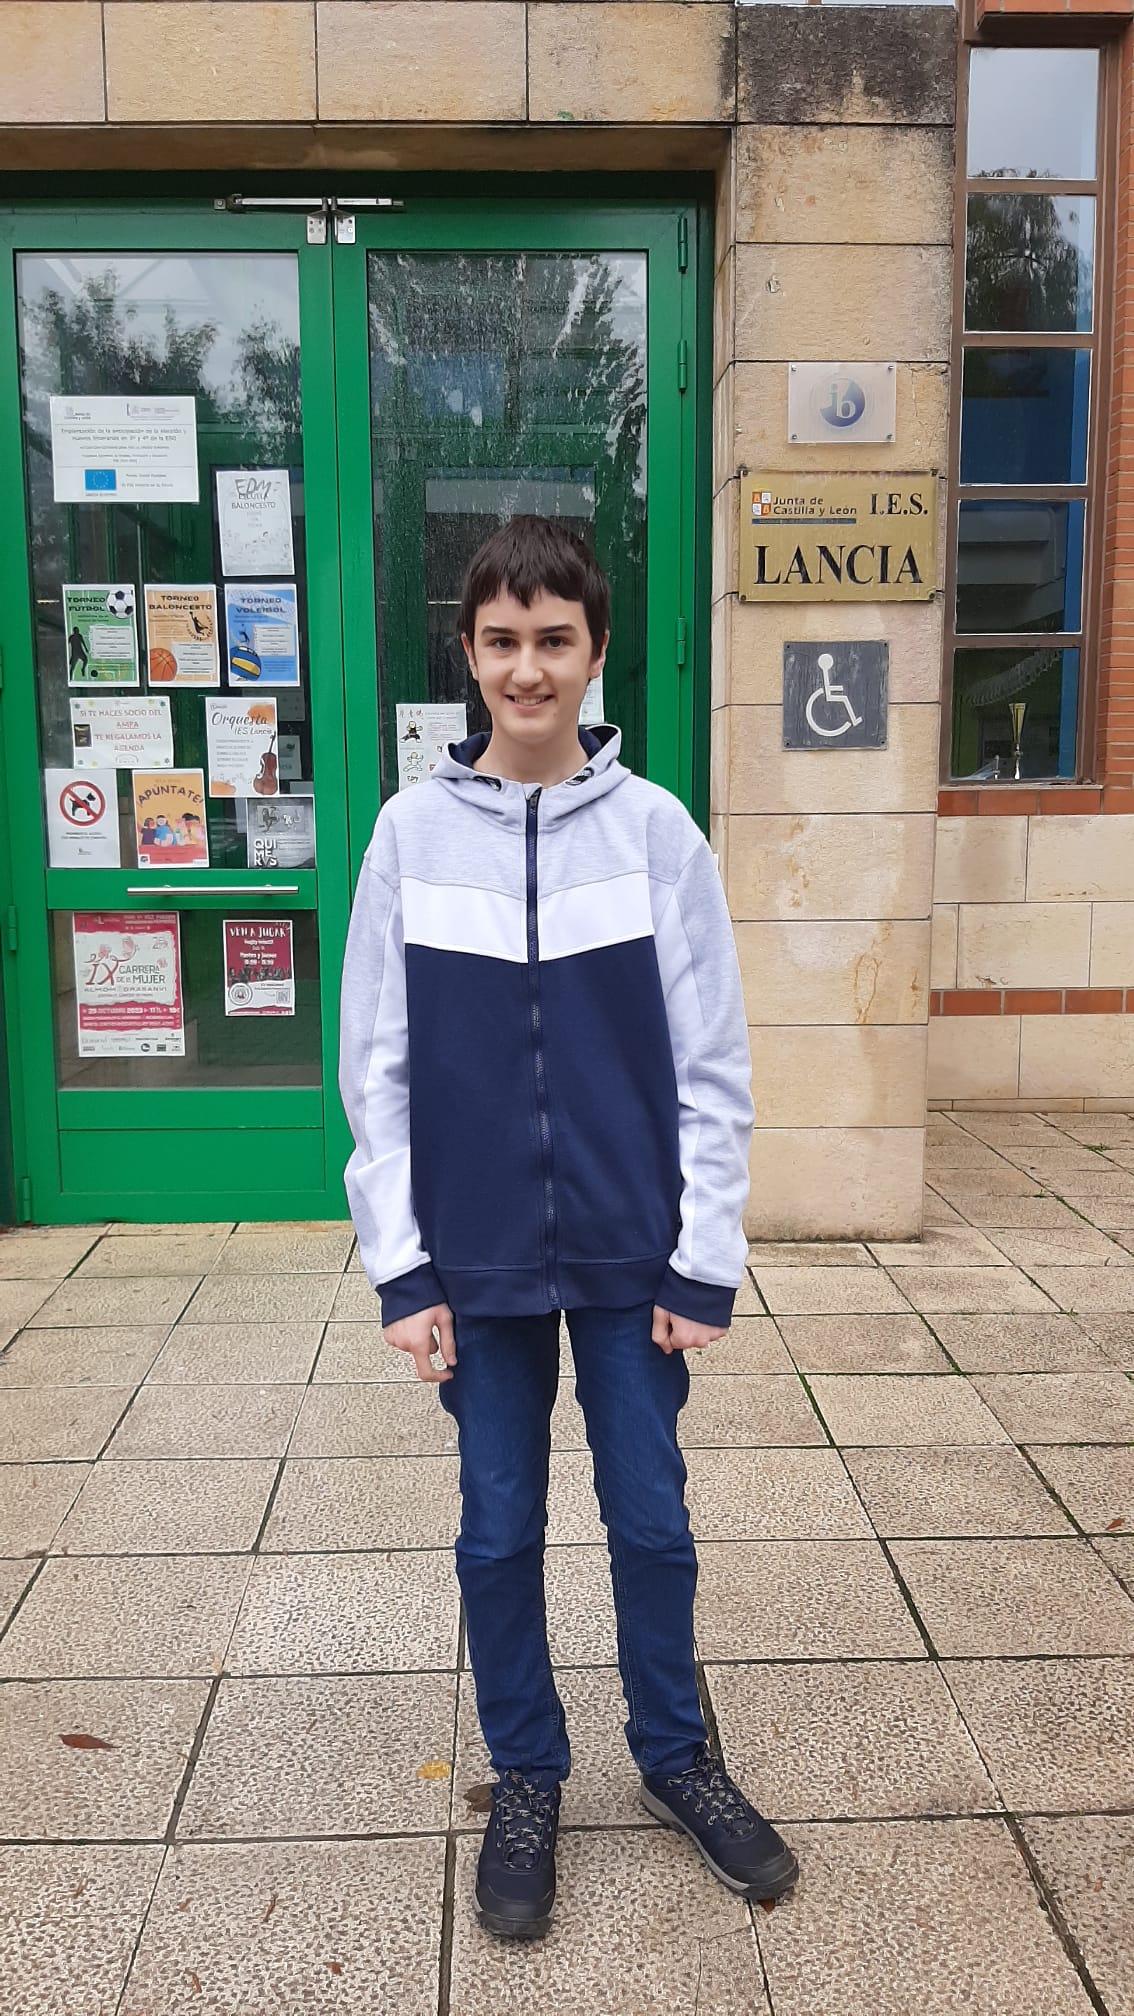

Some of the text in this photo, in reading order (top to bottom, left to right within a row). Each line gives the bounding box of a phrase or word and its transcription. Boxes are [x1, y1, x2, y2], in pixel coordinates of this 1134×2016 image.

[231, 502, 276, 510] BALONCESTO
[773, 496, 824, 506] Junta de
[869, 492, 929, 516] I.E.S.
[773, 505, 857, 517] Castilla y León
[753, 544, 924, 586] LANCIA
[98, 709, 122, 717] HACES
[124, 709, 147, 717] SOCIO
[149, 709, 162, 717] DEL
[211, 712, 268, 730] Orquesta
[234, 727, 249, 735] IES
[106, 733, 152, 741] REGALAMOS
[258, 927, 286, 938] JUGAR
[118, 965, 161, 975] CARRERA
[132, 975, 166, 984] MUJER
